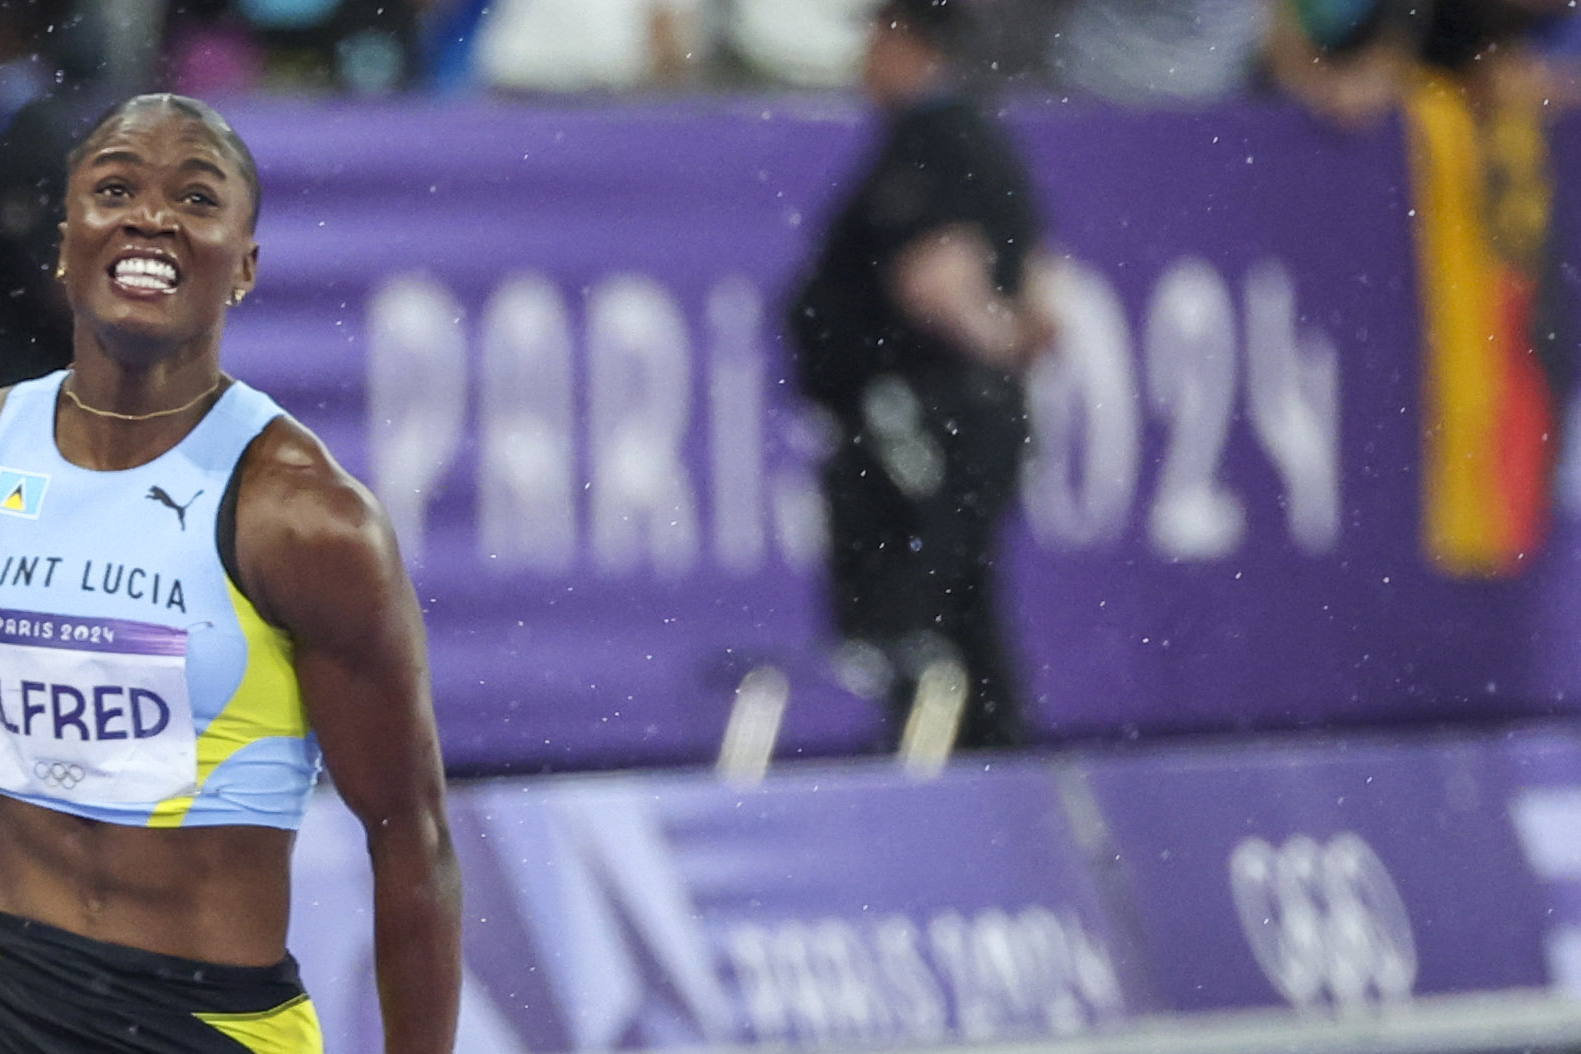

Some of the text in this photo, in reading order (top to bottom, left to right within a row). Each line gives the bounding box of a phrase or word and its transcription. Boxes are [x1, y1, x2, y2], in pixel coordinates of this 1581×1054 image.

[1021, 256, 1341, 562] 024
[80, 559, 187, 614] LUCIA
[59, 624, 115, 644] 2024
